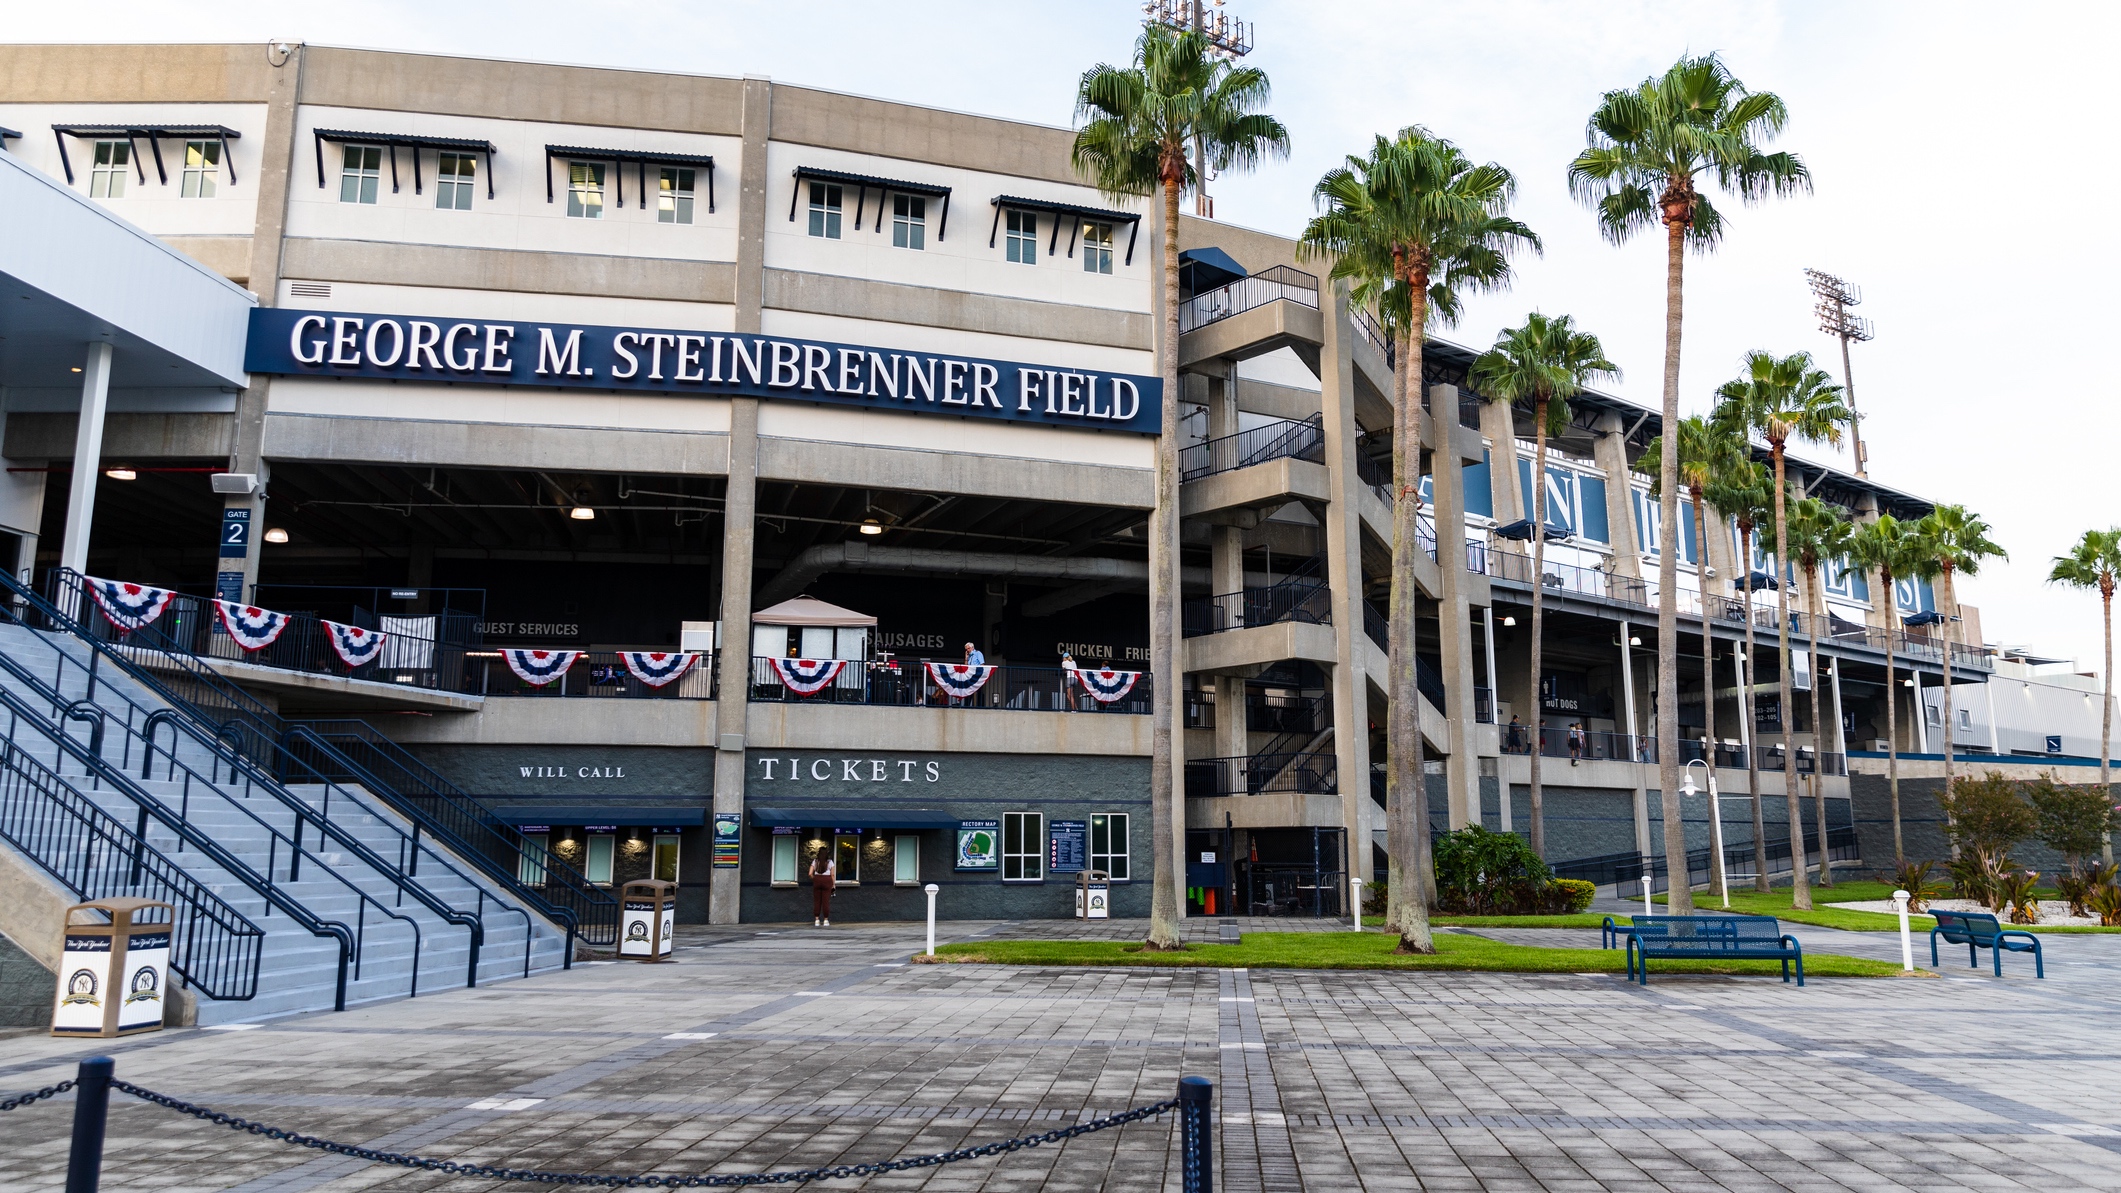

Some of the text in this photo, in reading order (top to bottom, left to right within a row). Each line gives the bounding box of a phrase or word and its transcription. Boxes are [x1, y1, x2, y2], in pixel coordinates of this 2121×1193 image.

[290, 315, 1140, 420] GEORGE M. STEINBRENNER FIELD
[227, 523, 243, 543] 2
[473, 622, 579, 635] GUEST SERVICES
[867, 631, 944, 648] SAUSAGES
[1057, 642, 1151, 660] CHICKEN FRIE
[1560, 698, 1578, 710] DOGS
[520, 766, 625, 778] WILL CALL
[758, 758, 940, 783] TICKETS
